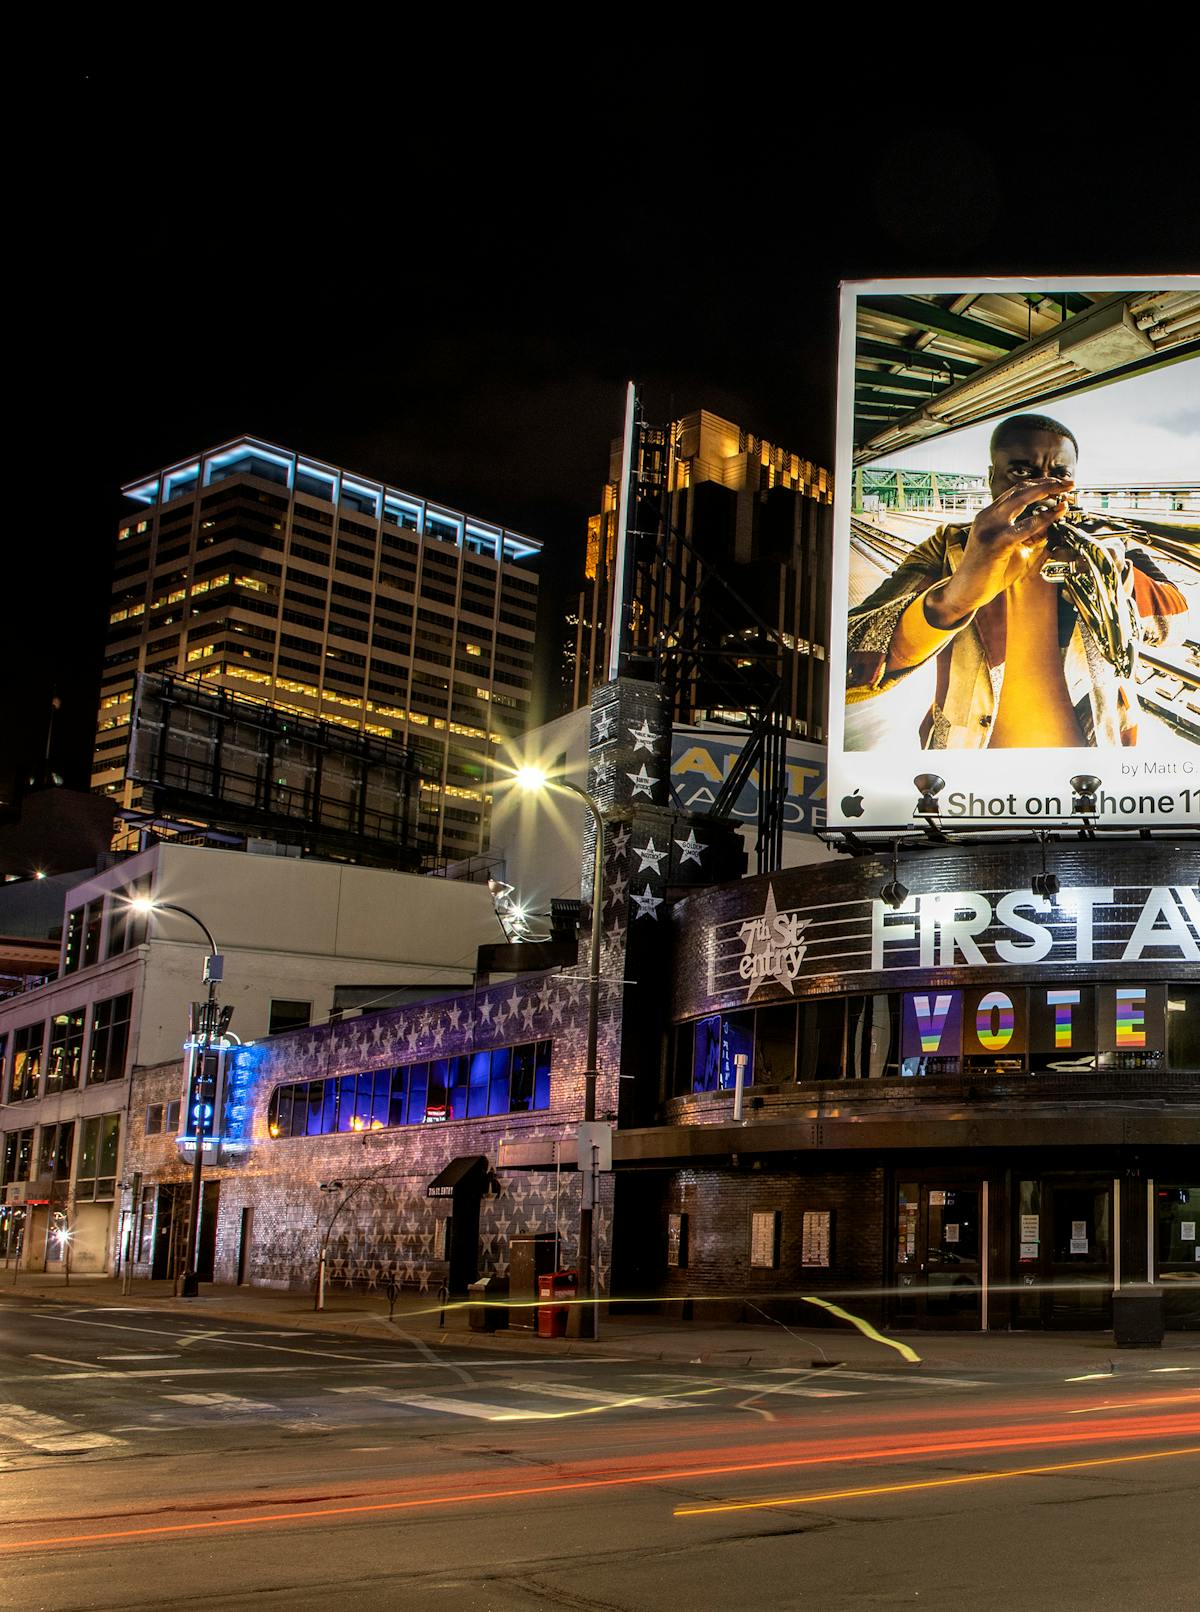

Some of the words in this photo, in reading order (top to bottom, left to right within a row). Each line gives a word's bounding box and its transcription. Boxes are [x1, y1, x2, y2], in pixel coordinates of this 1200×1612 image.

[1121, 762, 1138, 777] by
[1144, 761, 1176, 774] Matt
[1182, 761, 1198, 774] G.
[948, 792, 1016, 817] Shot
[1025, 797, 1061, 815] on
[1072, 790, 1174, 814] ihone
[739, 919, 772, 955] 7th
[771, 913, 805, 948] St
[871, 887, 1114, 971] FIRST
[740, 942, 807, 979] entry
[913, 989, 1146, 1052] VOTE
